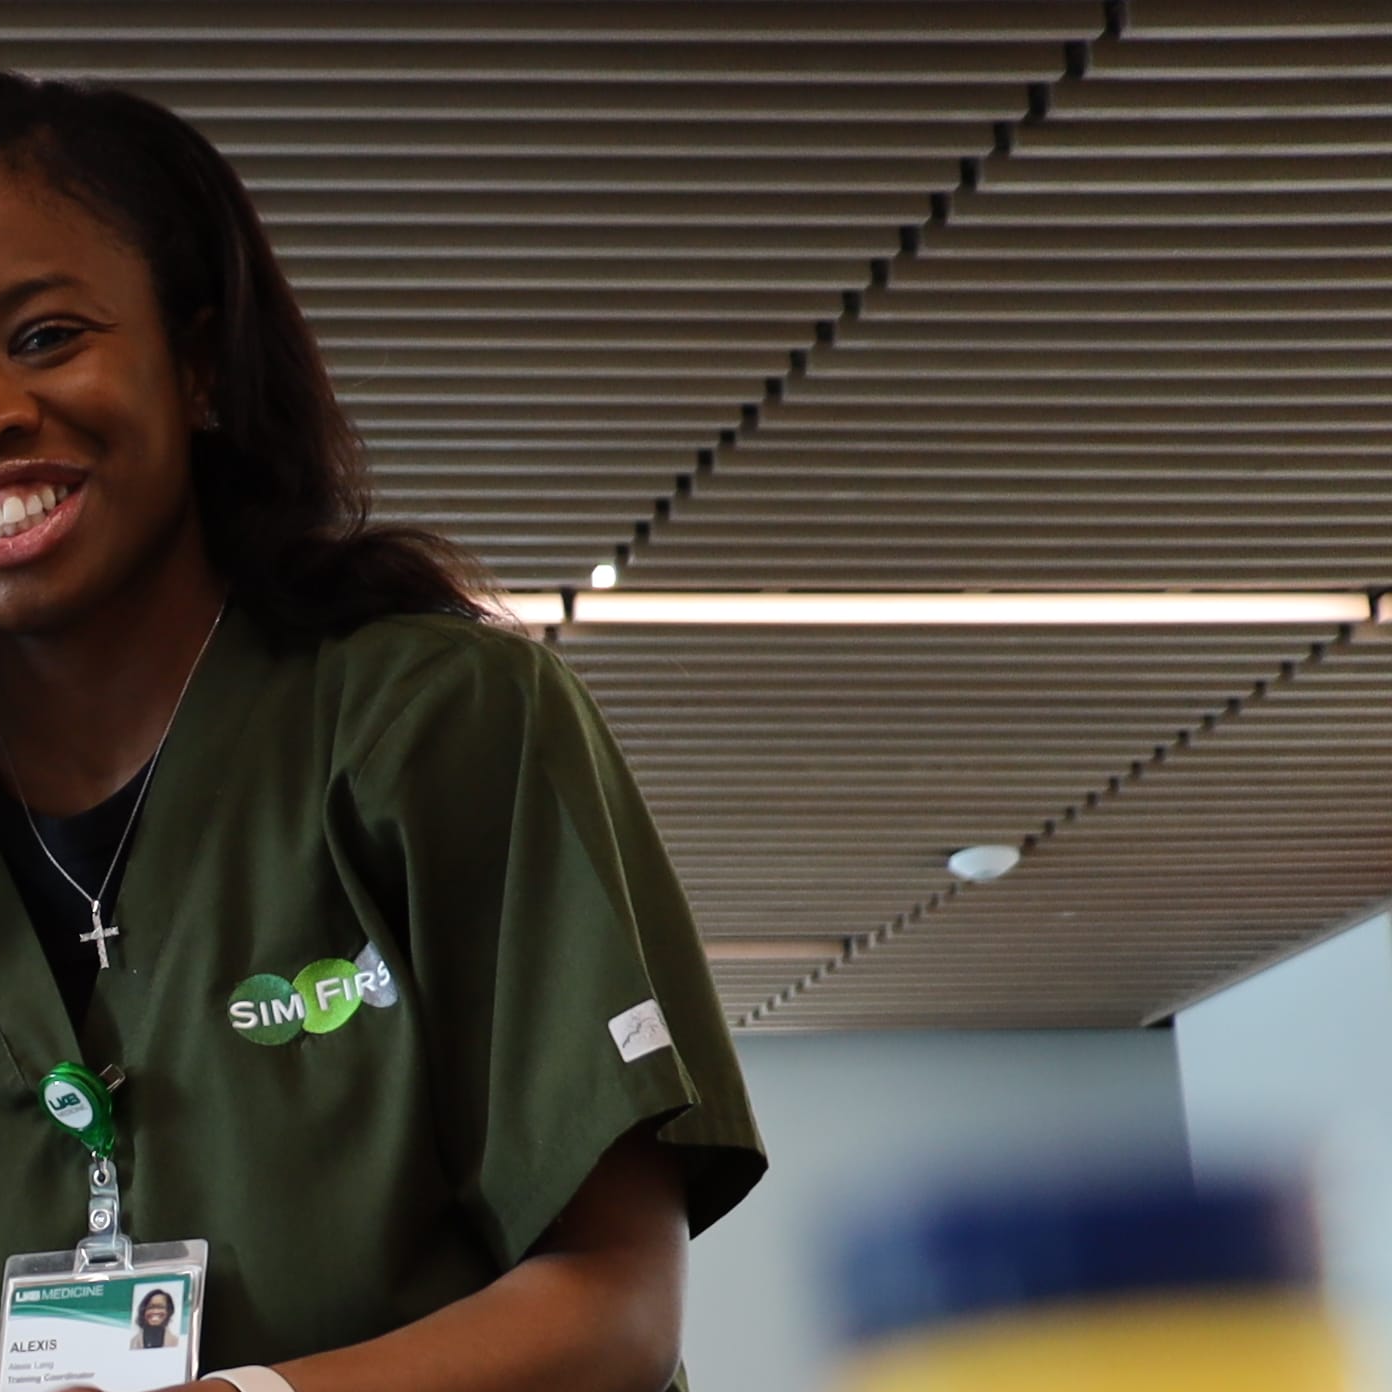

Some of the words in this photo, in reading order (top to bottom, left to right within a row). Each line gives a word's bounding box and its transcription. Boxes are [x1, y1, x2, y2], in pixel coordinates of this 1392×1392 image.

[229, 993, 305, 1029] SIM
[315, 960, 390, 1011] FIRS
[41, 1285, 104, 1300] MEDICINE
[10, 1339, 57, 1353] ALEXIS
